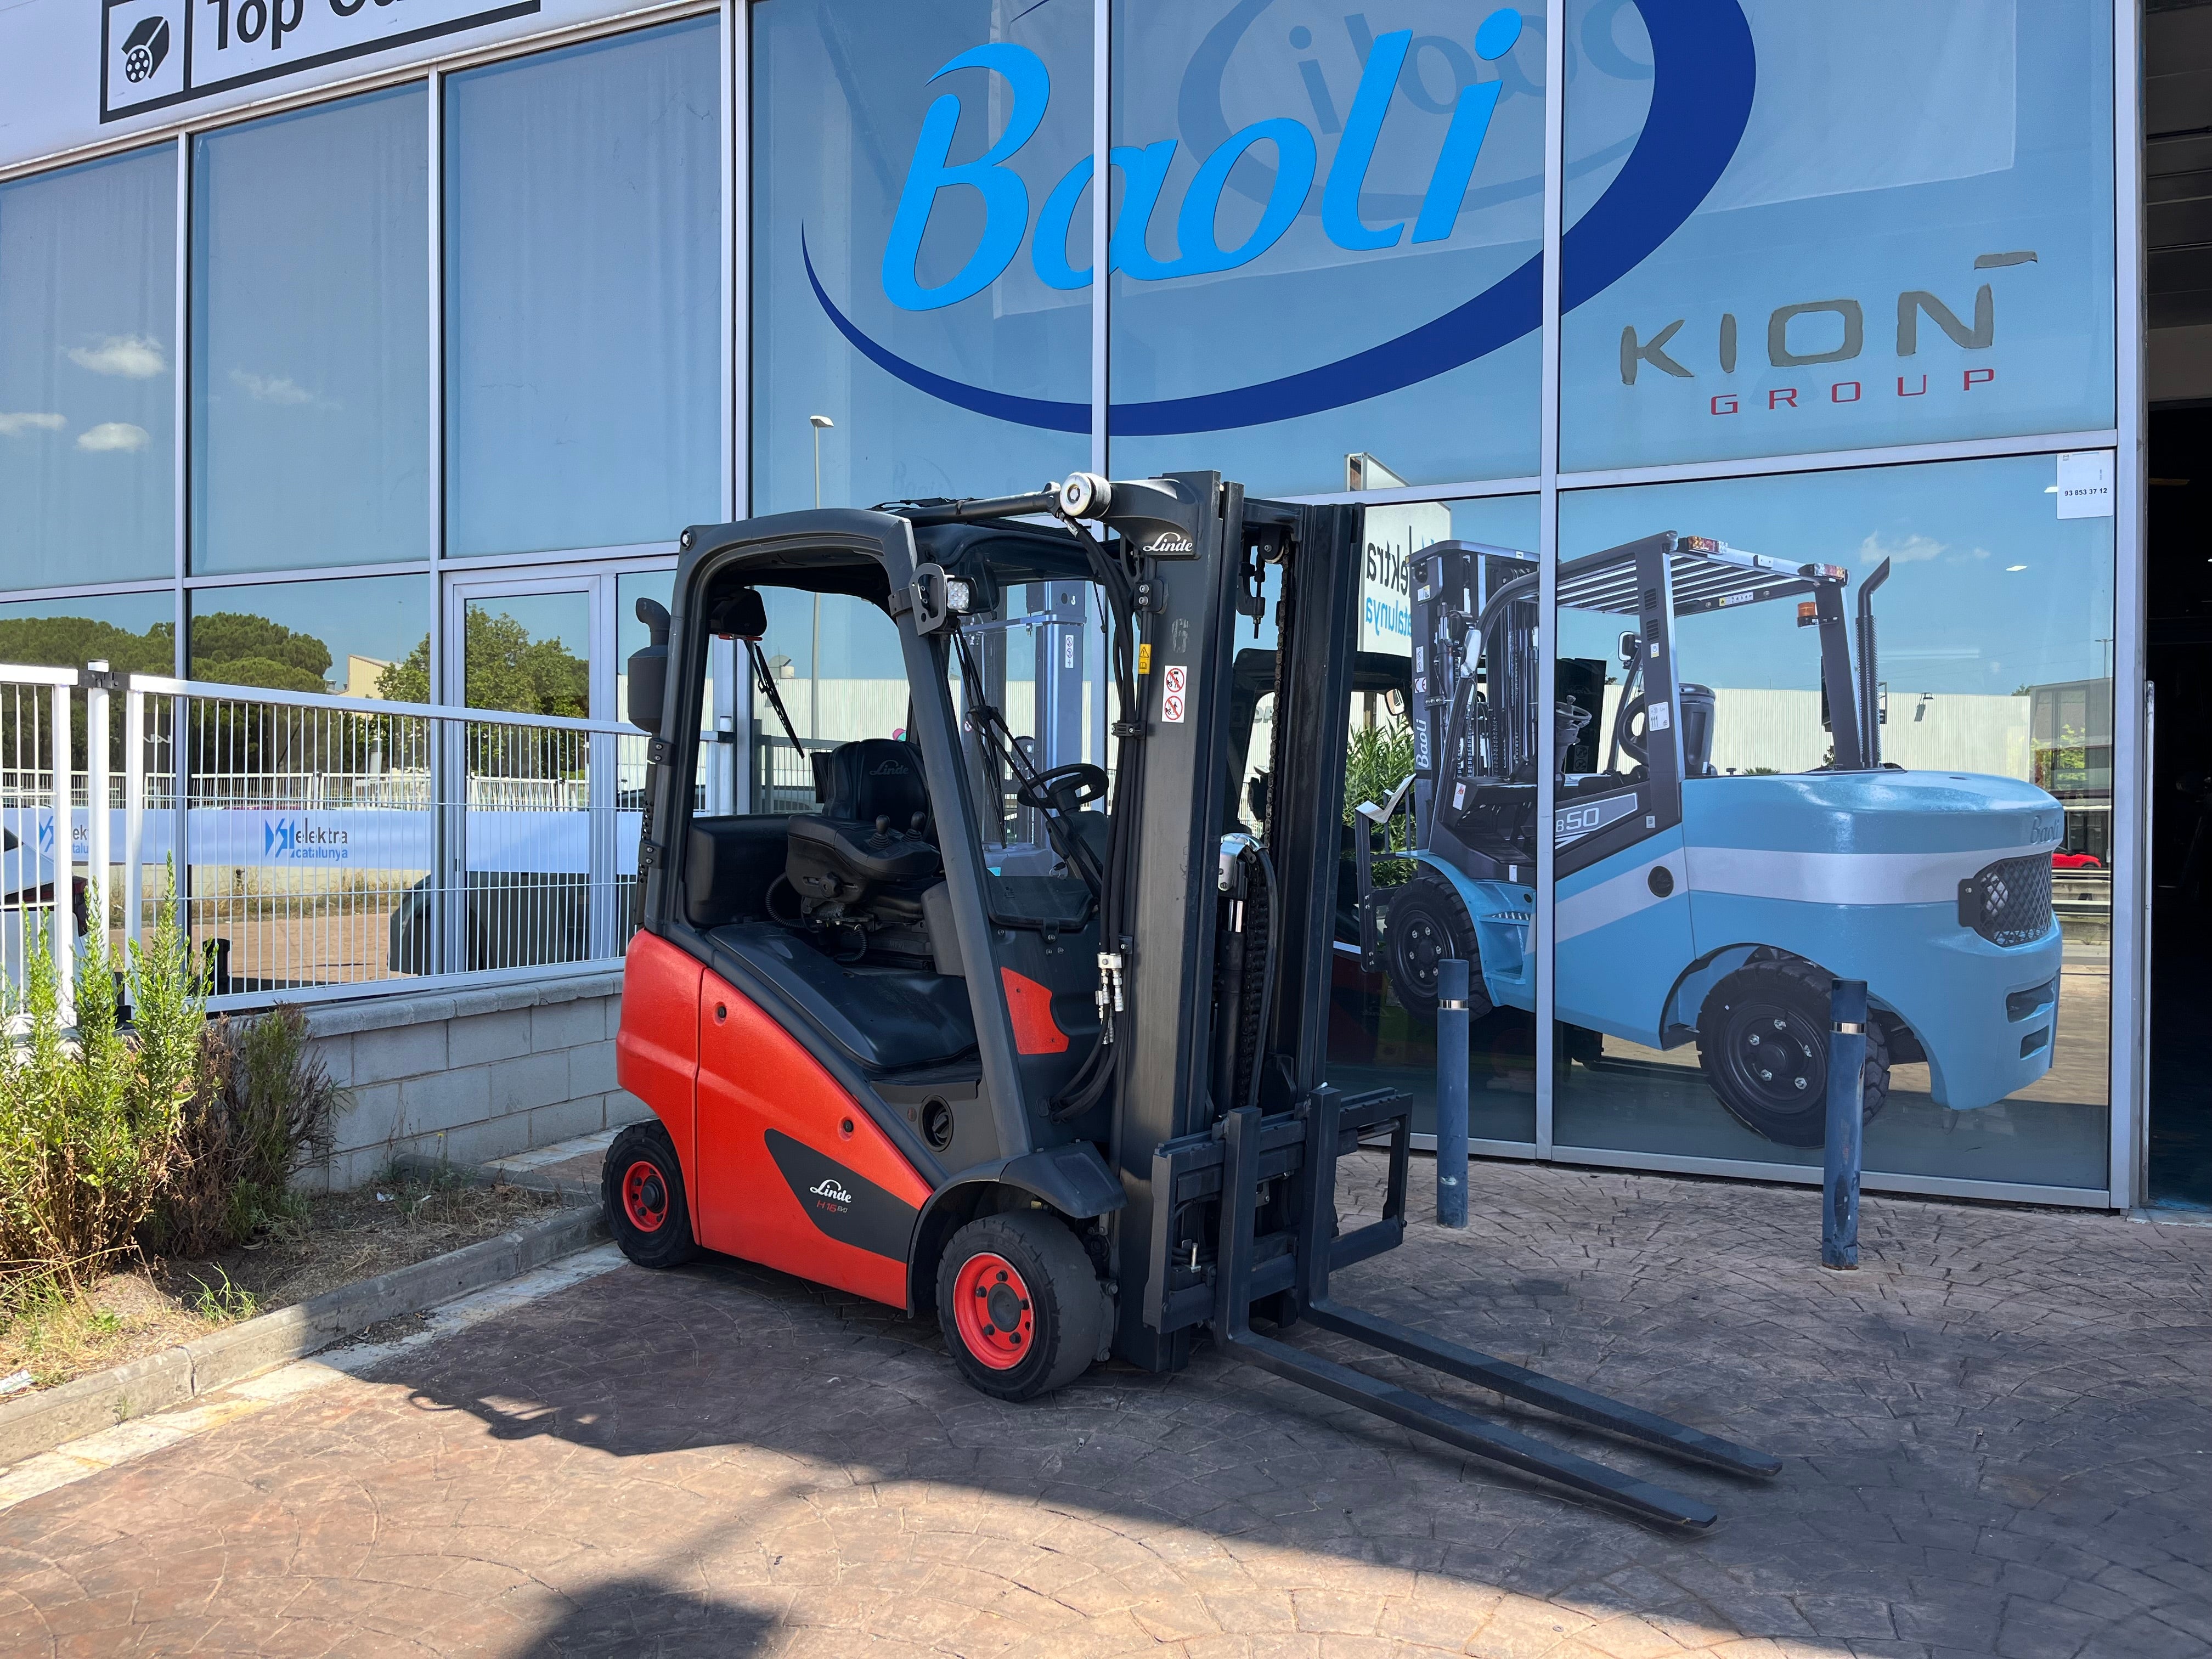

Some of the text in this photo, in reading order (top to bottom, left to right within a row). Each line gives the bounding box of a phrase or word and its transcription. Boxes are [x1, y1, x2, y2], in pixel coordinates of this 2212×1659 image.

[207, 0, 303, 50] Top
[882, 8, 1522, 312] Baoli
[1621, 282, 1994, 386] KION
[1710, 368, 1995, 415] GROUP
[1143, 532, 1193, 552] Linde
[1415, 718, 1429, 769] Baoli
[869, 759, 910, 776] Linde
[296, 817, 348, 844] elektra
[2030, 815, 2059, 845] Baoli
[296, 846, 348, 861] catalunya
[809, 1179, 851, 1203] Linde
